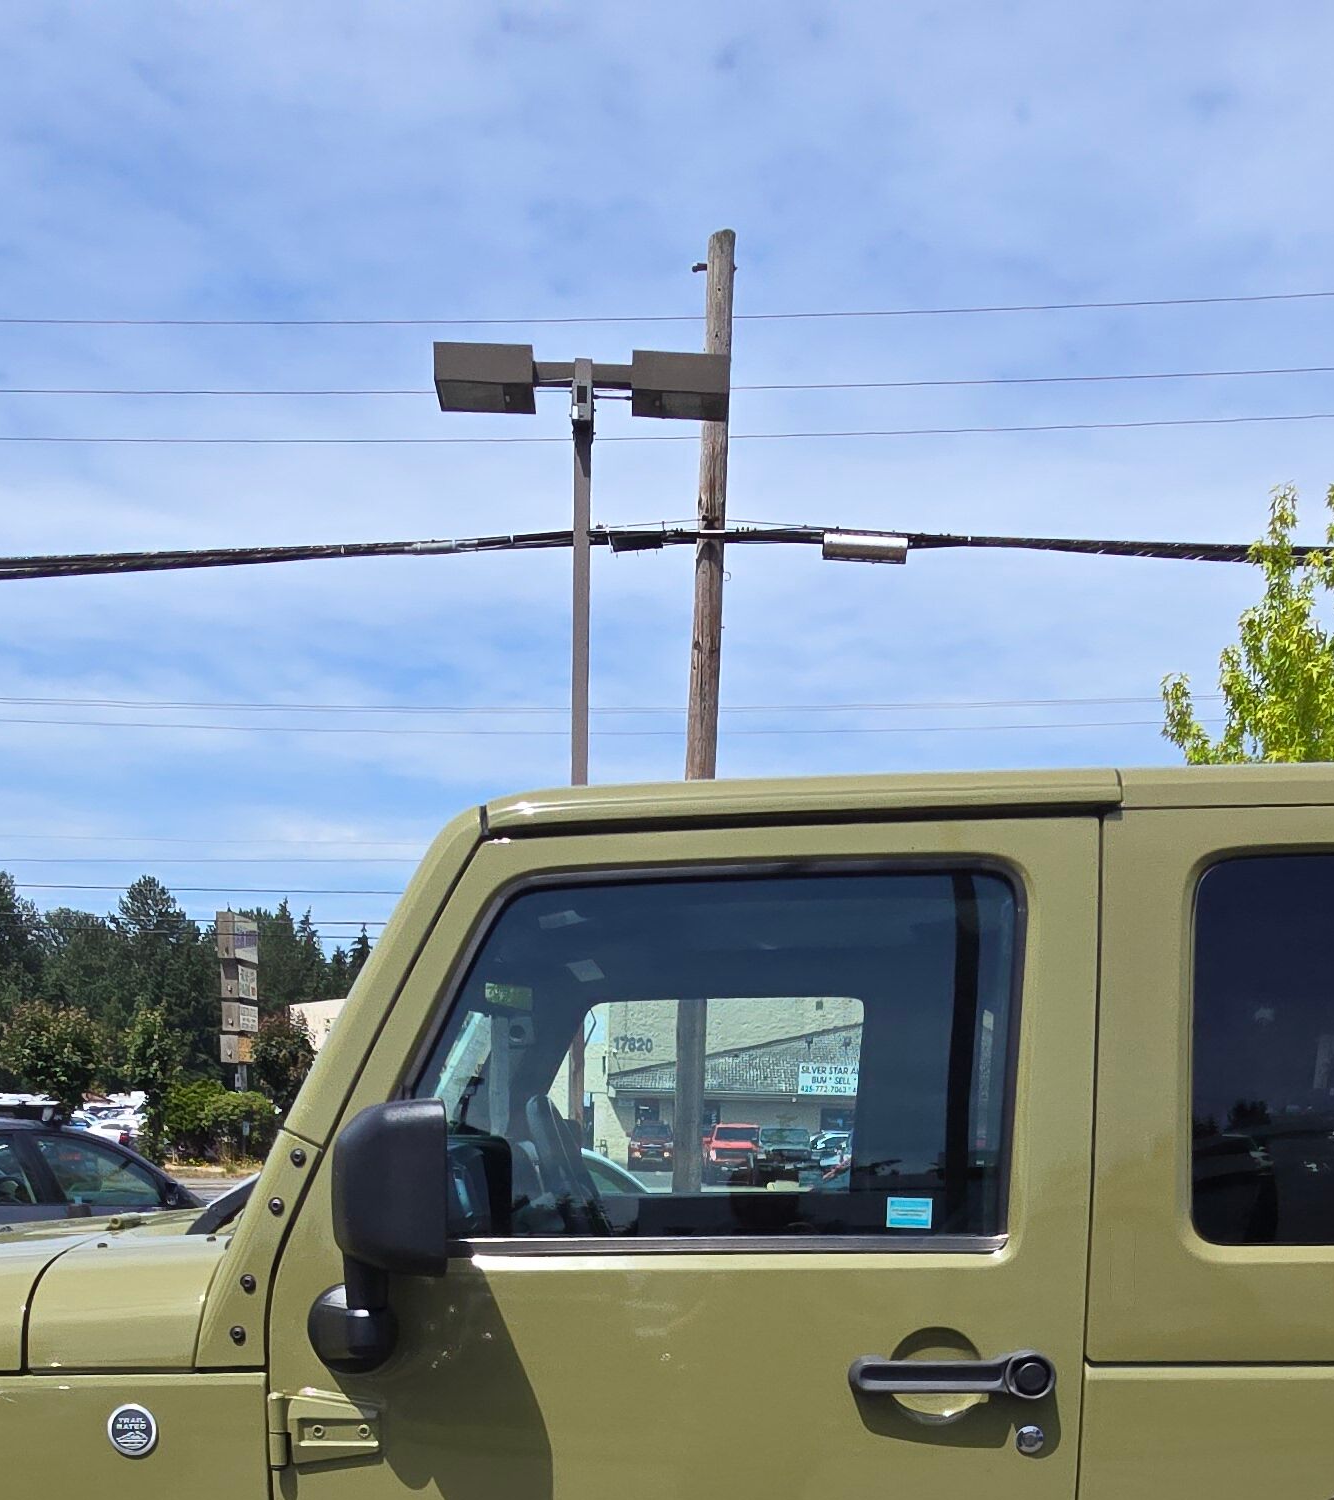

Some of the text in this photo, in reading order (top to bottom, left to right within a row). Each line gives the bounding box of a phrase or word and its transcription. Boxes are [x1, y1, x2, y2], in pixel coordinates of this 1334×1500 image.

[613, 1035, 653, 1054] 17820
[801, 1065, 827, 1075] SILVER
[829, 1066, 849, 1075] STAR
